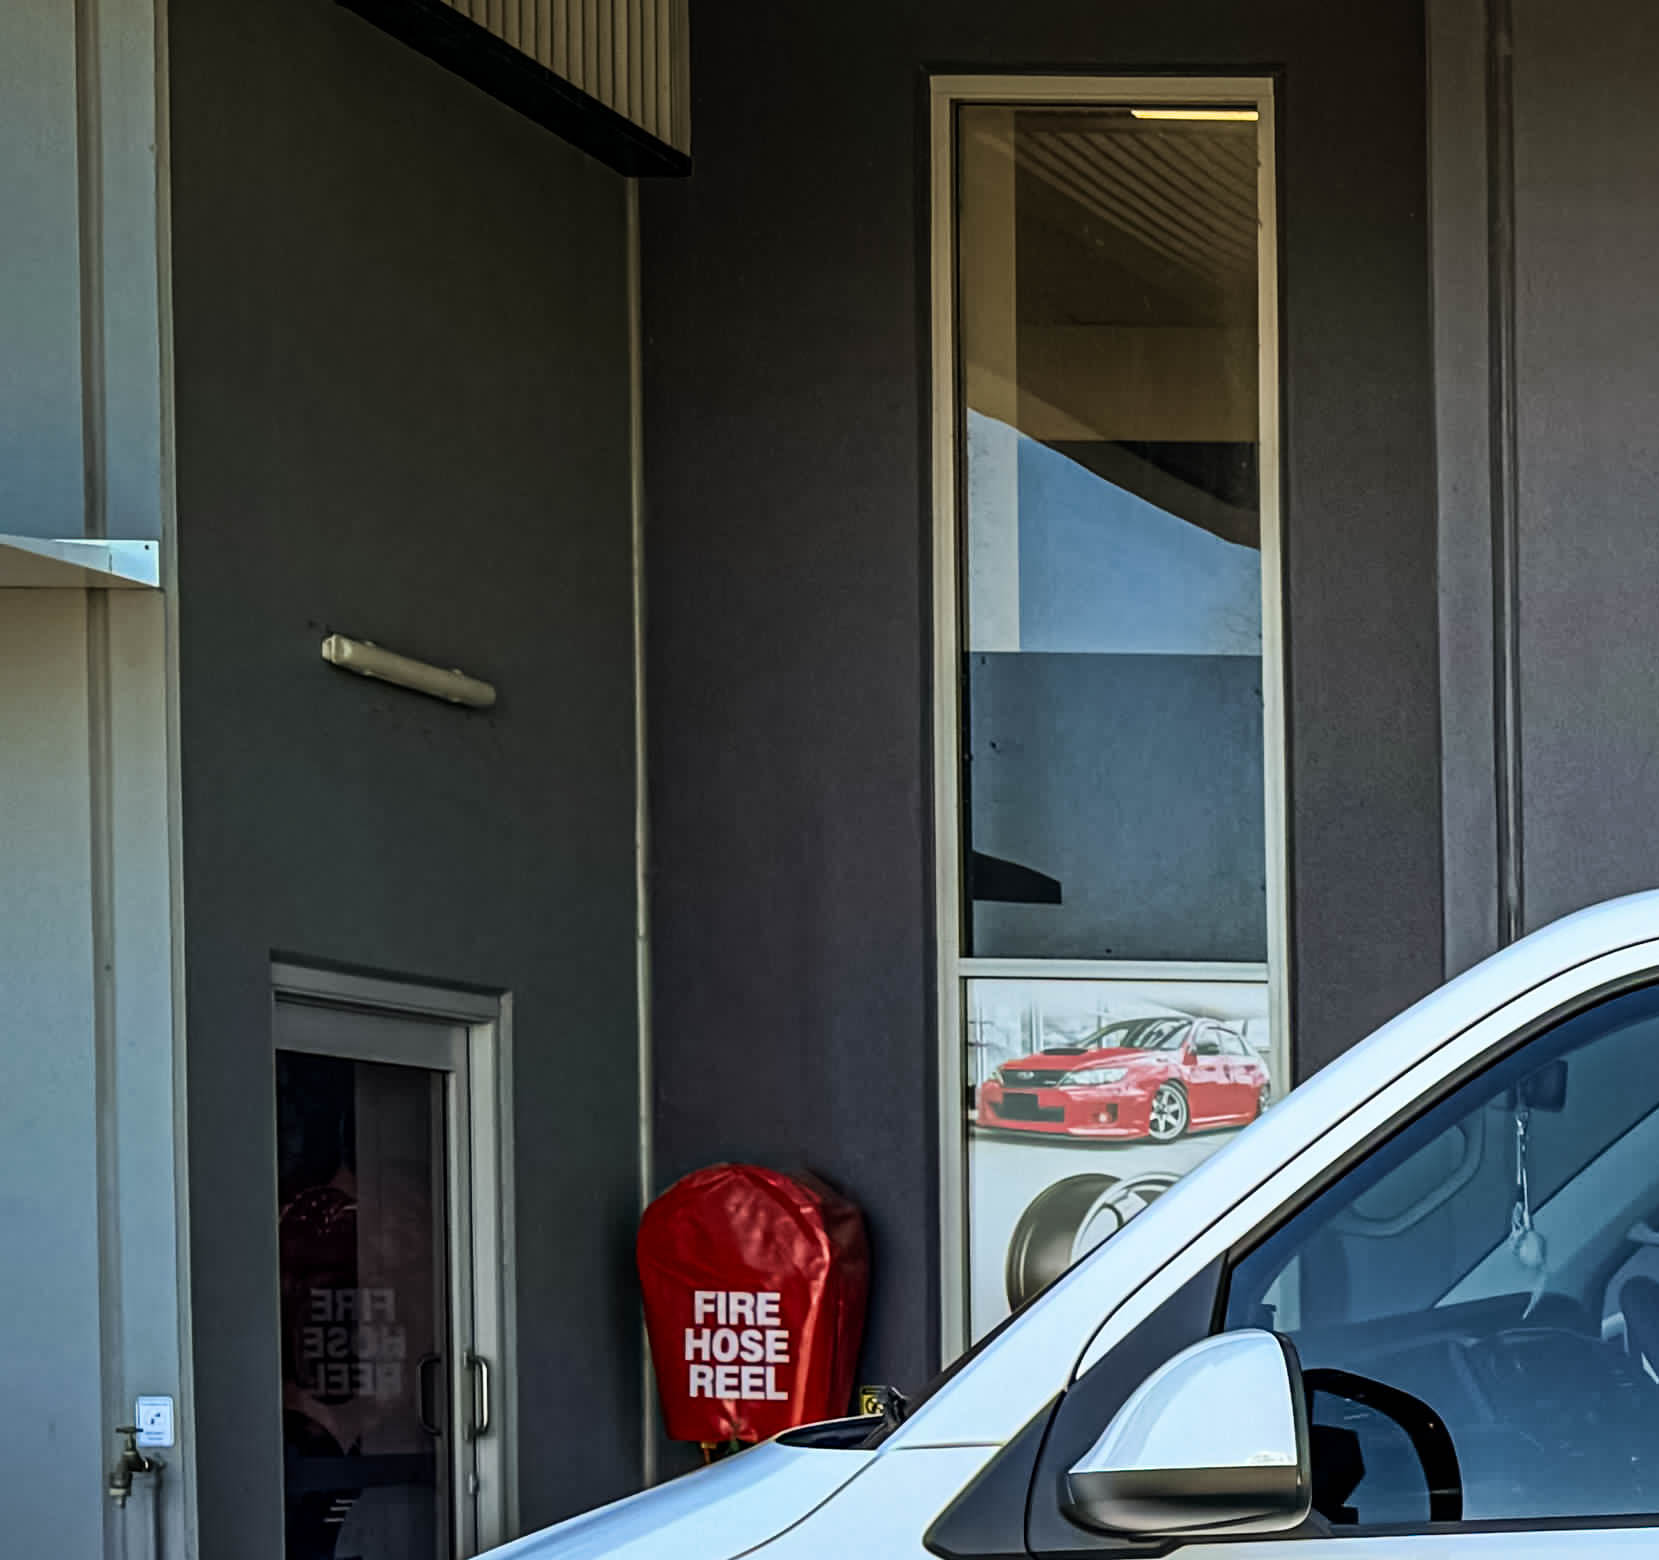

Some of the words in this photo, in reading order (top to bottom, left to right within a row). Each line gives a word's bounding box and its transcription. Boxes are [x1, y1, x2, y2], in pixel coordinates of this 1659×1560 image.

[694, 1291, 781, 1326] FIRE
[685, 1328, 790, 1363] HOSE
[689, 1365, 788, 1400] REEL
